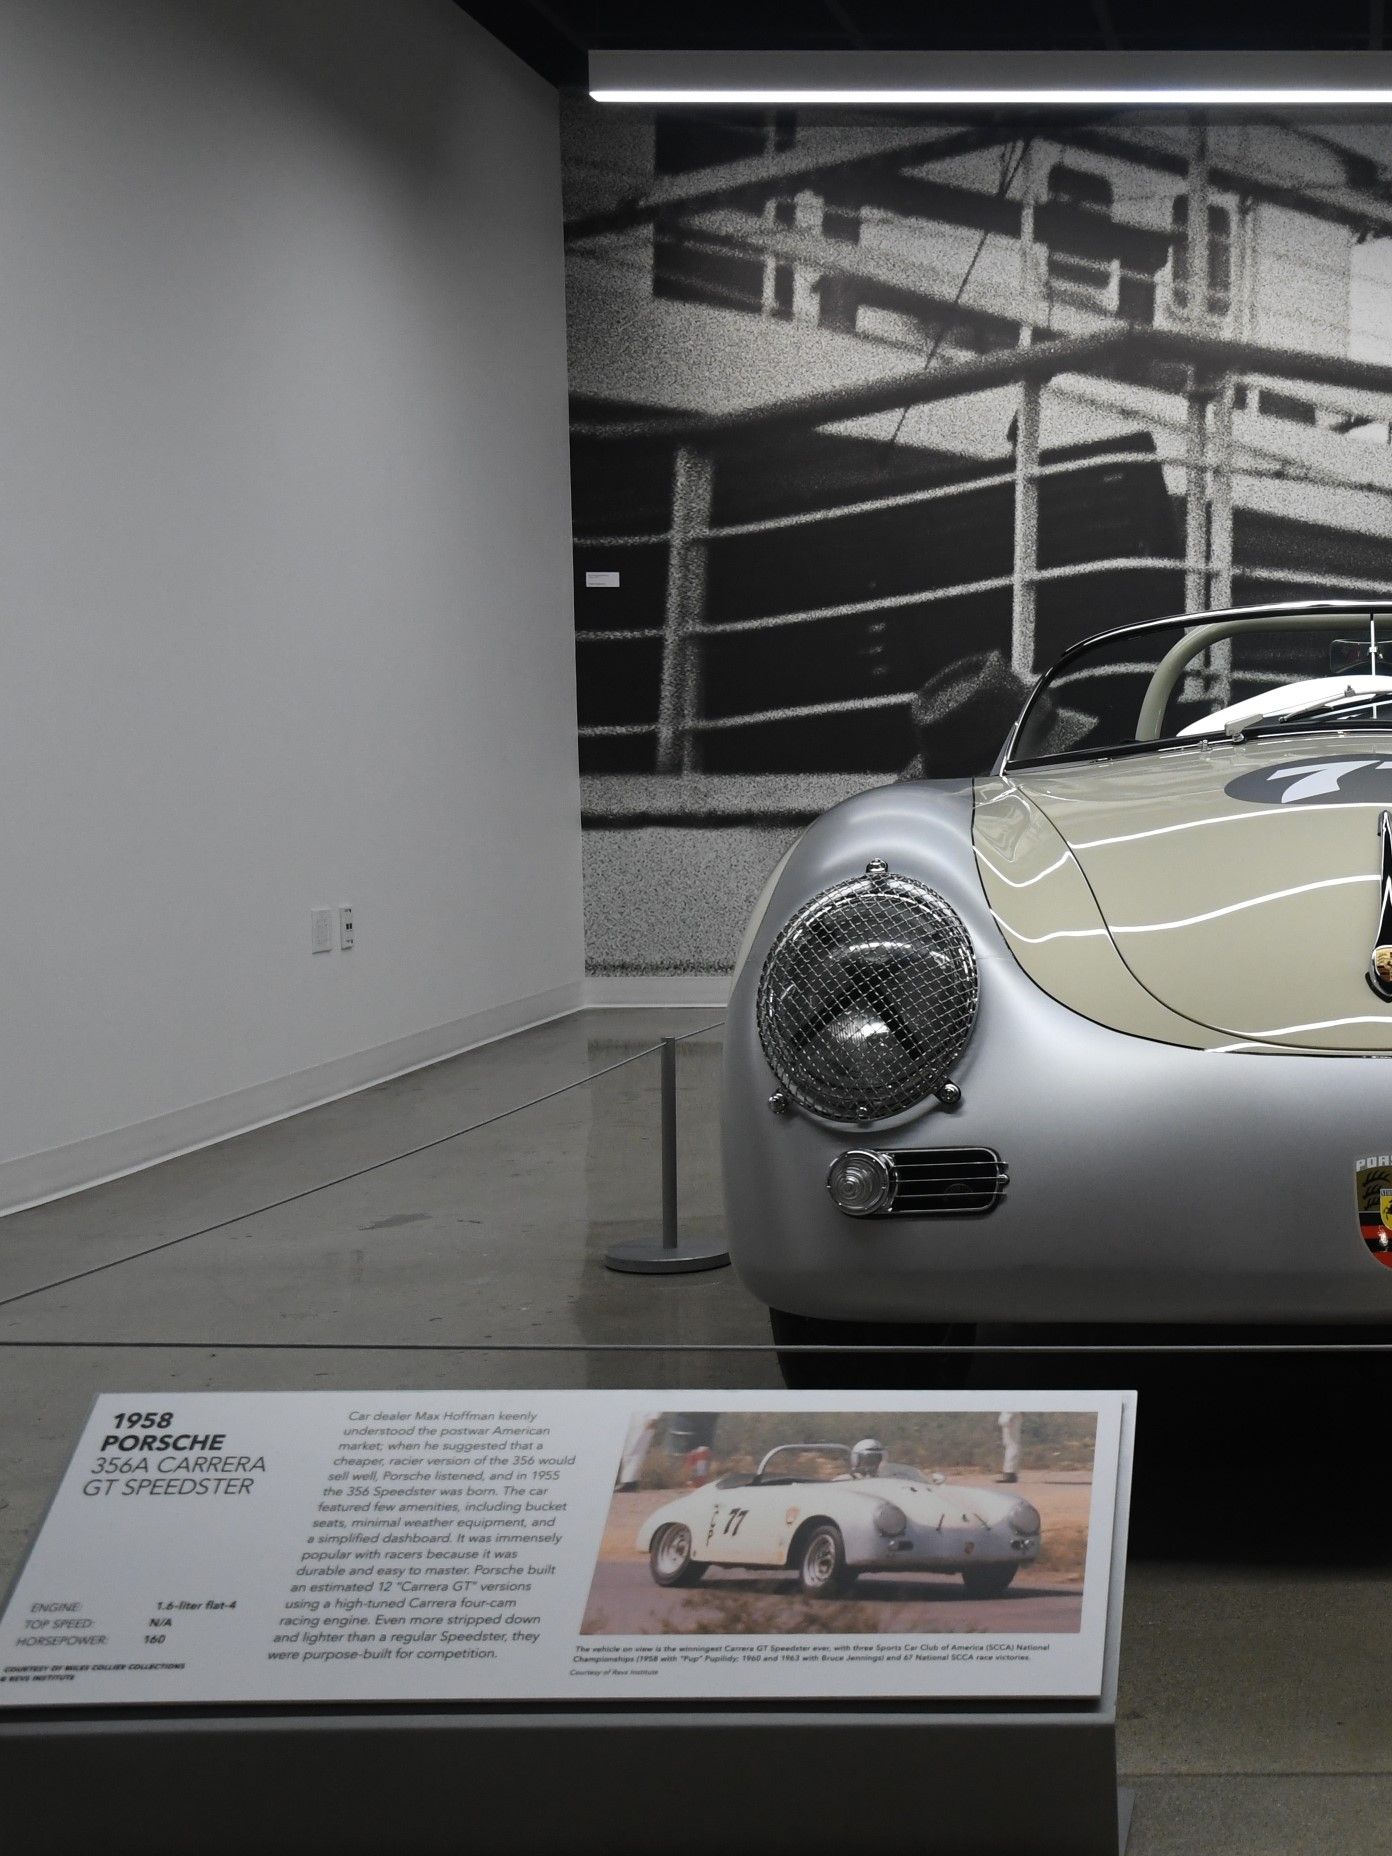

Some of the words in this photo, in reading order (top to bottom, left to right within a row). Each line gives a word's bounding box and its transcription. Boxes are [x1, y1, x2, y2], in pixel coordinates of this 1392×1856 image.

[114, 1412, 174, 1429] 1958
[348, 1411, 372, 1421] Car
[373, 1411, 413, 1422] dealer
[413, 1411, 441, 1421] Max
[442, 1410, 495, 1421] Hoffman
[498, 1411, 538, 1423] keenly
[342, 1425, 417, 1436] understood
[418, 1426, 438, 1436] the
[438, 1428, 491, 1438] postwar
[492, 1426, 550, 1436] American
[100, 1434, 226, 1452] PORSCHE
[387, 1441, 421, 1451] when
[423, 1440, 440, 1451] he
[442, 1440, 508, 1453] suggested
[510, 1440, 534, 1451] that
[536, 1443, 544, 1451] a
[91, 1457, 149, 1475] 356A
[157, 1456, 266, 1474] CARRERA
[333, 1456, 386, 1469] cheaper,
[388, 1456, 425, 1466] racier
[426, 1456, 471, 1466] version
[473, 1455, 489, 1466] of
[489, 1456, 509, 1466] the
[512, 1455, 535, 1466] 356
[538, 1455, 577, 1465] would
[327, 1470, 350, 1482] sell
[351, 1471, 379, 1483] well,
[382, 1470, 432, 1481] Porsche
[434, 1470, 485, 1482] listened,
[488, 1471, 514, 1481] and
[516, 1472, 527, 1480] in
[532, 1471, 560, 1481] 1955
[82, 1479, 120, 1497] GT
[121, 1478, 254, 1496] SPEEDSTER
[323, 1486, 344, 1497] the
[346, 1486, 370, 1497] 356
[373, 1486, 438, 1499] Speedster
[466, 1486, 498, 1496] born.
[504, 1486, 526, 1496] The
[317, 1501, 372, 1513] featured
[372, 1501, 397, 1512] few
[398, 1502, 460, 1513] amenities,
[464, 1501, 522, 1514] including
[525, 1501, 567, 1512] bucket
[312, 1519, 347, 1529] seats,
[351, 1517, 402, 1528] minimal
[403, 1517, 455, 1528] weather
[456, 1518, 527, 1530] equipment,
[531, 1517, 556, 1527] and
[307, 1536, 315, 1544] a
[317, 1532, 381, 1546] simplified
[381, 1532, 452, 1544] dashboard.
[457, 1533, 466, 1543] It
[495, 1532, 563, 1546] immensely
[300, 1549, 353, 1563] popular
[353, 1549, 381, 1560] with
[384, 1552, 423, 1560] racers
[425, 1548, 480, 1560] because
[482, 1549, 491, 1559] it
[494, 1551, 518, 1559] was
[295, 1564, 346, 1576] durable
[348, 1565, 375, 1576] and
[376, 1568, 407, 1579] easy
[408, 1566, 422, 1576] to
[424, 1566, 470, 1576] master.
[474, 1564, 524, 1575] Porsche
[527, 1564, 556, 1575] built
[290, 1585, 307, 1593] an
[309, 1581, 375, 1593] estimated
[379, 1581, 393, 1592] 12
[397, 1581, 449, 1593] "Carrera
[452, 1581, 478, 1592] GT"
[480, 1581, 532, 1592] versions
[285, 1599, 320, 1612] using
[323, 1601, 332, 1609] a
[333, 1597, 407, 1612] high-tuned
[408, 1597, 457, 1609] Carrera
[460, 1597, 517, 1608] four-cam
[25, 1619, 51, 1630] TOP
[149, 1618, 172, 1627] N/A
[278, 1615, 321, 1629] racing
[323, 1615, 371, 1629] engine.
[375, 1614, 406, 1626] Even
[410, 1617, 444, 1625] more
[447, 1613, 503, 1627] stripped
[505, 1613, 541, 1625] down
[144, 1634, 166, 1645] 160
[272, 1632, 301, 1644] and
[301, 1631, 345, 1646] lighter
[347, 1631, 376, 1643] than
[378, 1634, 387, 1642] a
[390, 1631, 438, 1645] regular
[439, 1630, 508, 1644] Speedster,
[511, 1630, 541, 1644] they
[267, 1651, 300, 1662] were
[301, 1648, 393, 1663] purpose-built
[395, 1647, 414, 1659] for
[416, 1648, 498, 1662] competition.
